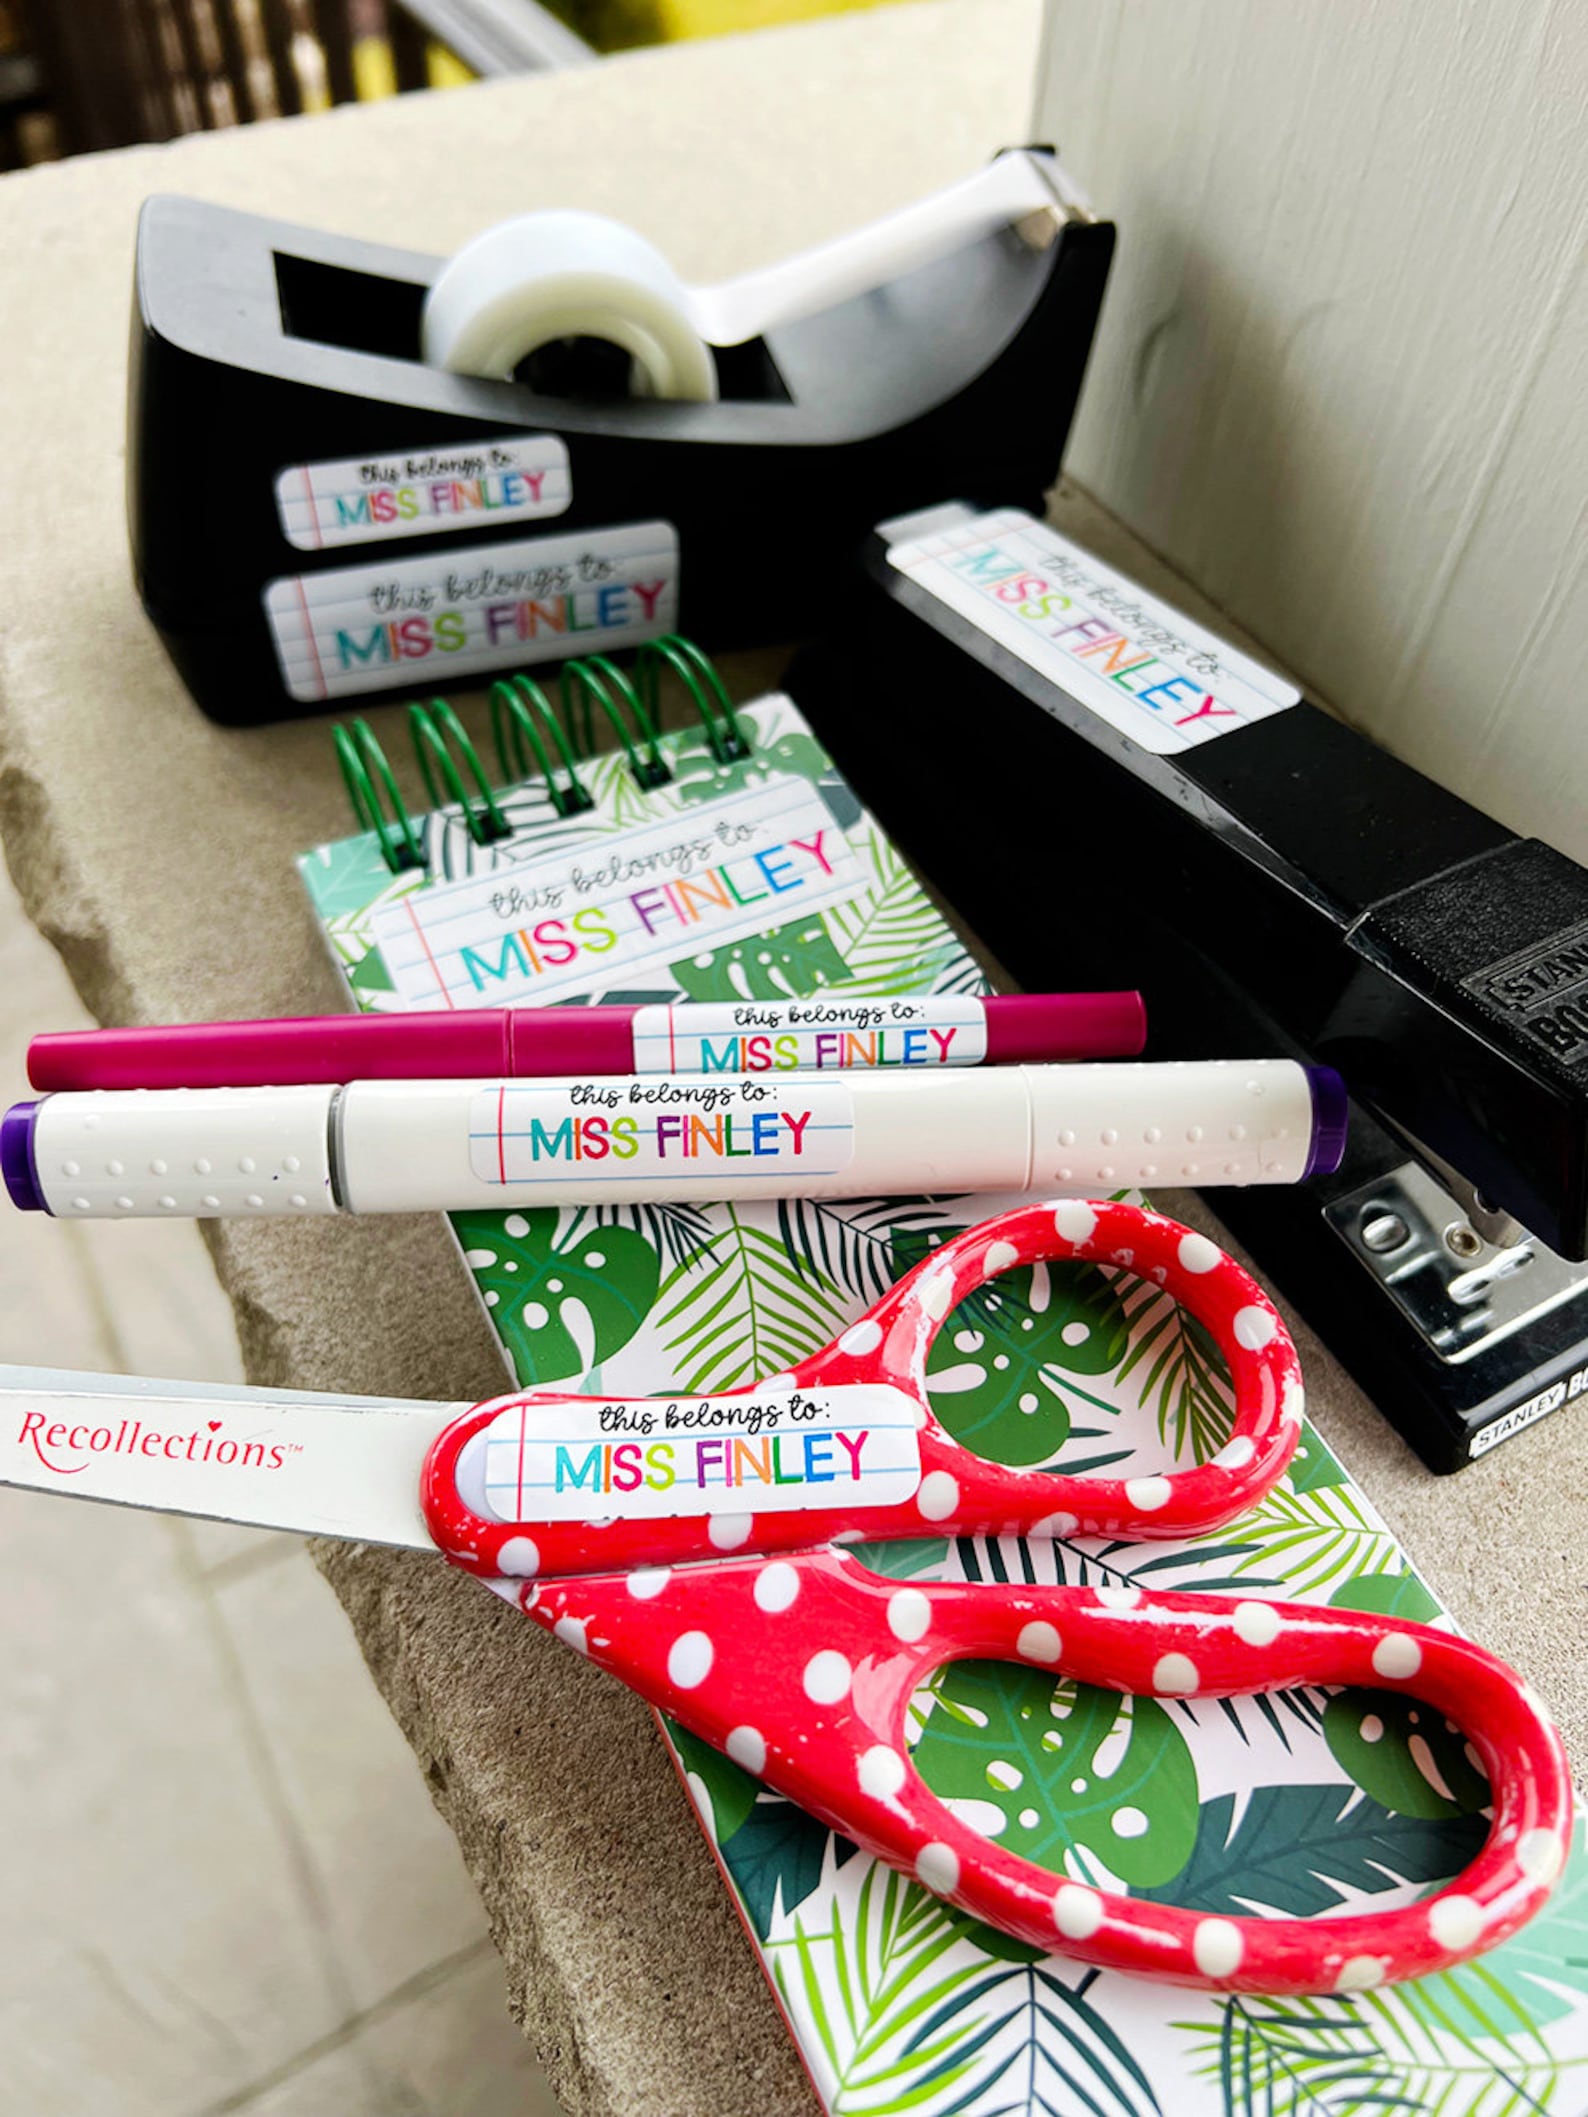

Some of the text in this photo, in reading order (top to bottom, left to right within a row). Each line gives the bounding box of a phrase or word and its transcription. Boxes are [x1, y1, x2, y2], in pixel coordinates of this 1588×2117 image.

[336, 471, 545, 530] MISS FINLEY
[369, 584, 437, 613] this
[445, 563, 573, 600] belongs
[1039, 555, 1090, 587] this
[1087, 587, 1187, 655] belongs
[335, 578, 667, 670] MISS FINLEY
[955, 546, 1237, 727] MISS FINLEY
[488, 886, 565, 918] this
[572, 838, 712, 891] belongs
[459, 829, 835, 993] MISS FINLEY
[733, 1002, 926, 1029] this belongs to:
[1527, 992, 1588, 1054] BO
[700, 1027, 957, 1073] MISS FINLEY
[568, 1081, 778, 1111] this belongs to:
[530, 1110, 812, 1161] MISS FINLEY
[598, 1394, 831, 1435] this belongs to:
[1479, 1389, 1560, 1448] STANLEY
[554, 1430, 870, 1494] MISS FINLEY
